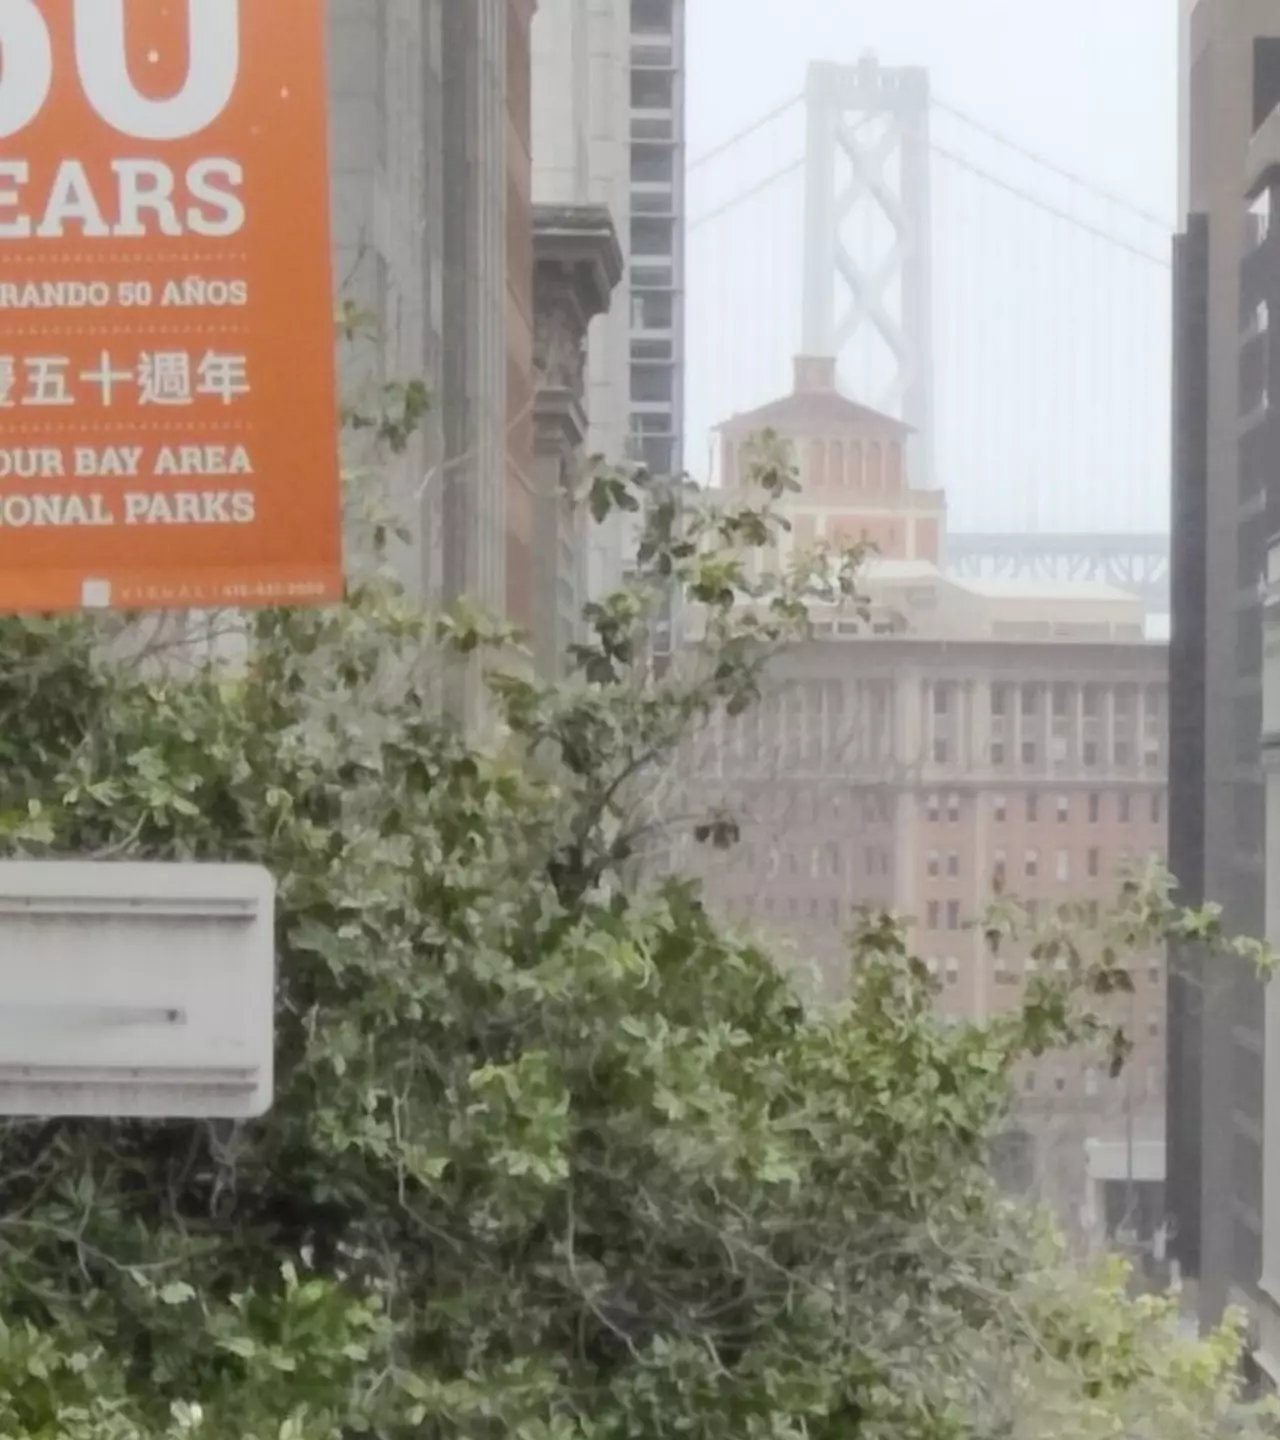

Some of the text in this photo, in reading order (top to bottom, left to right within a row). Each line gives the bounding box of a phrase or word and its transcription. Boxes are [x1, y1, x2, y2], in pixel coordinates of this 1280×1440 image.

[117, 281, 152, 307] 50
[160, 275, 248, 307] AÑOS
[74, 446, 143, 476] BAY
[153, 445, 254, 475] AREA
[0, 491, 256, 527] ONAL PARKS
